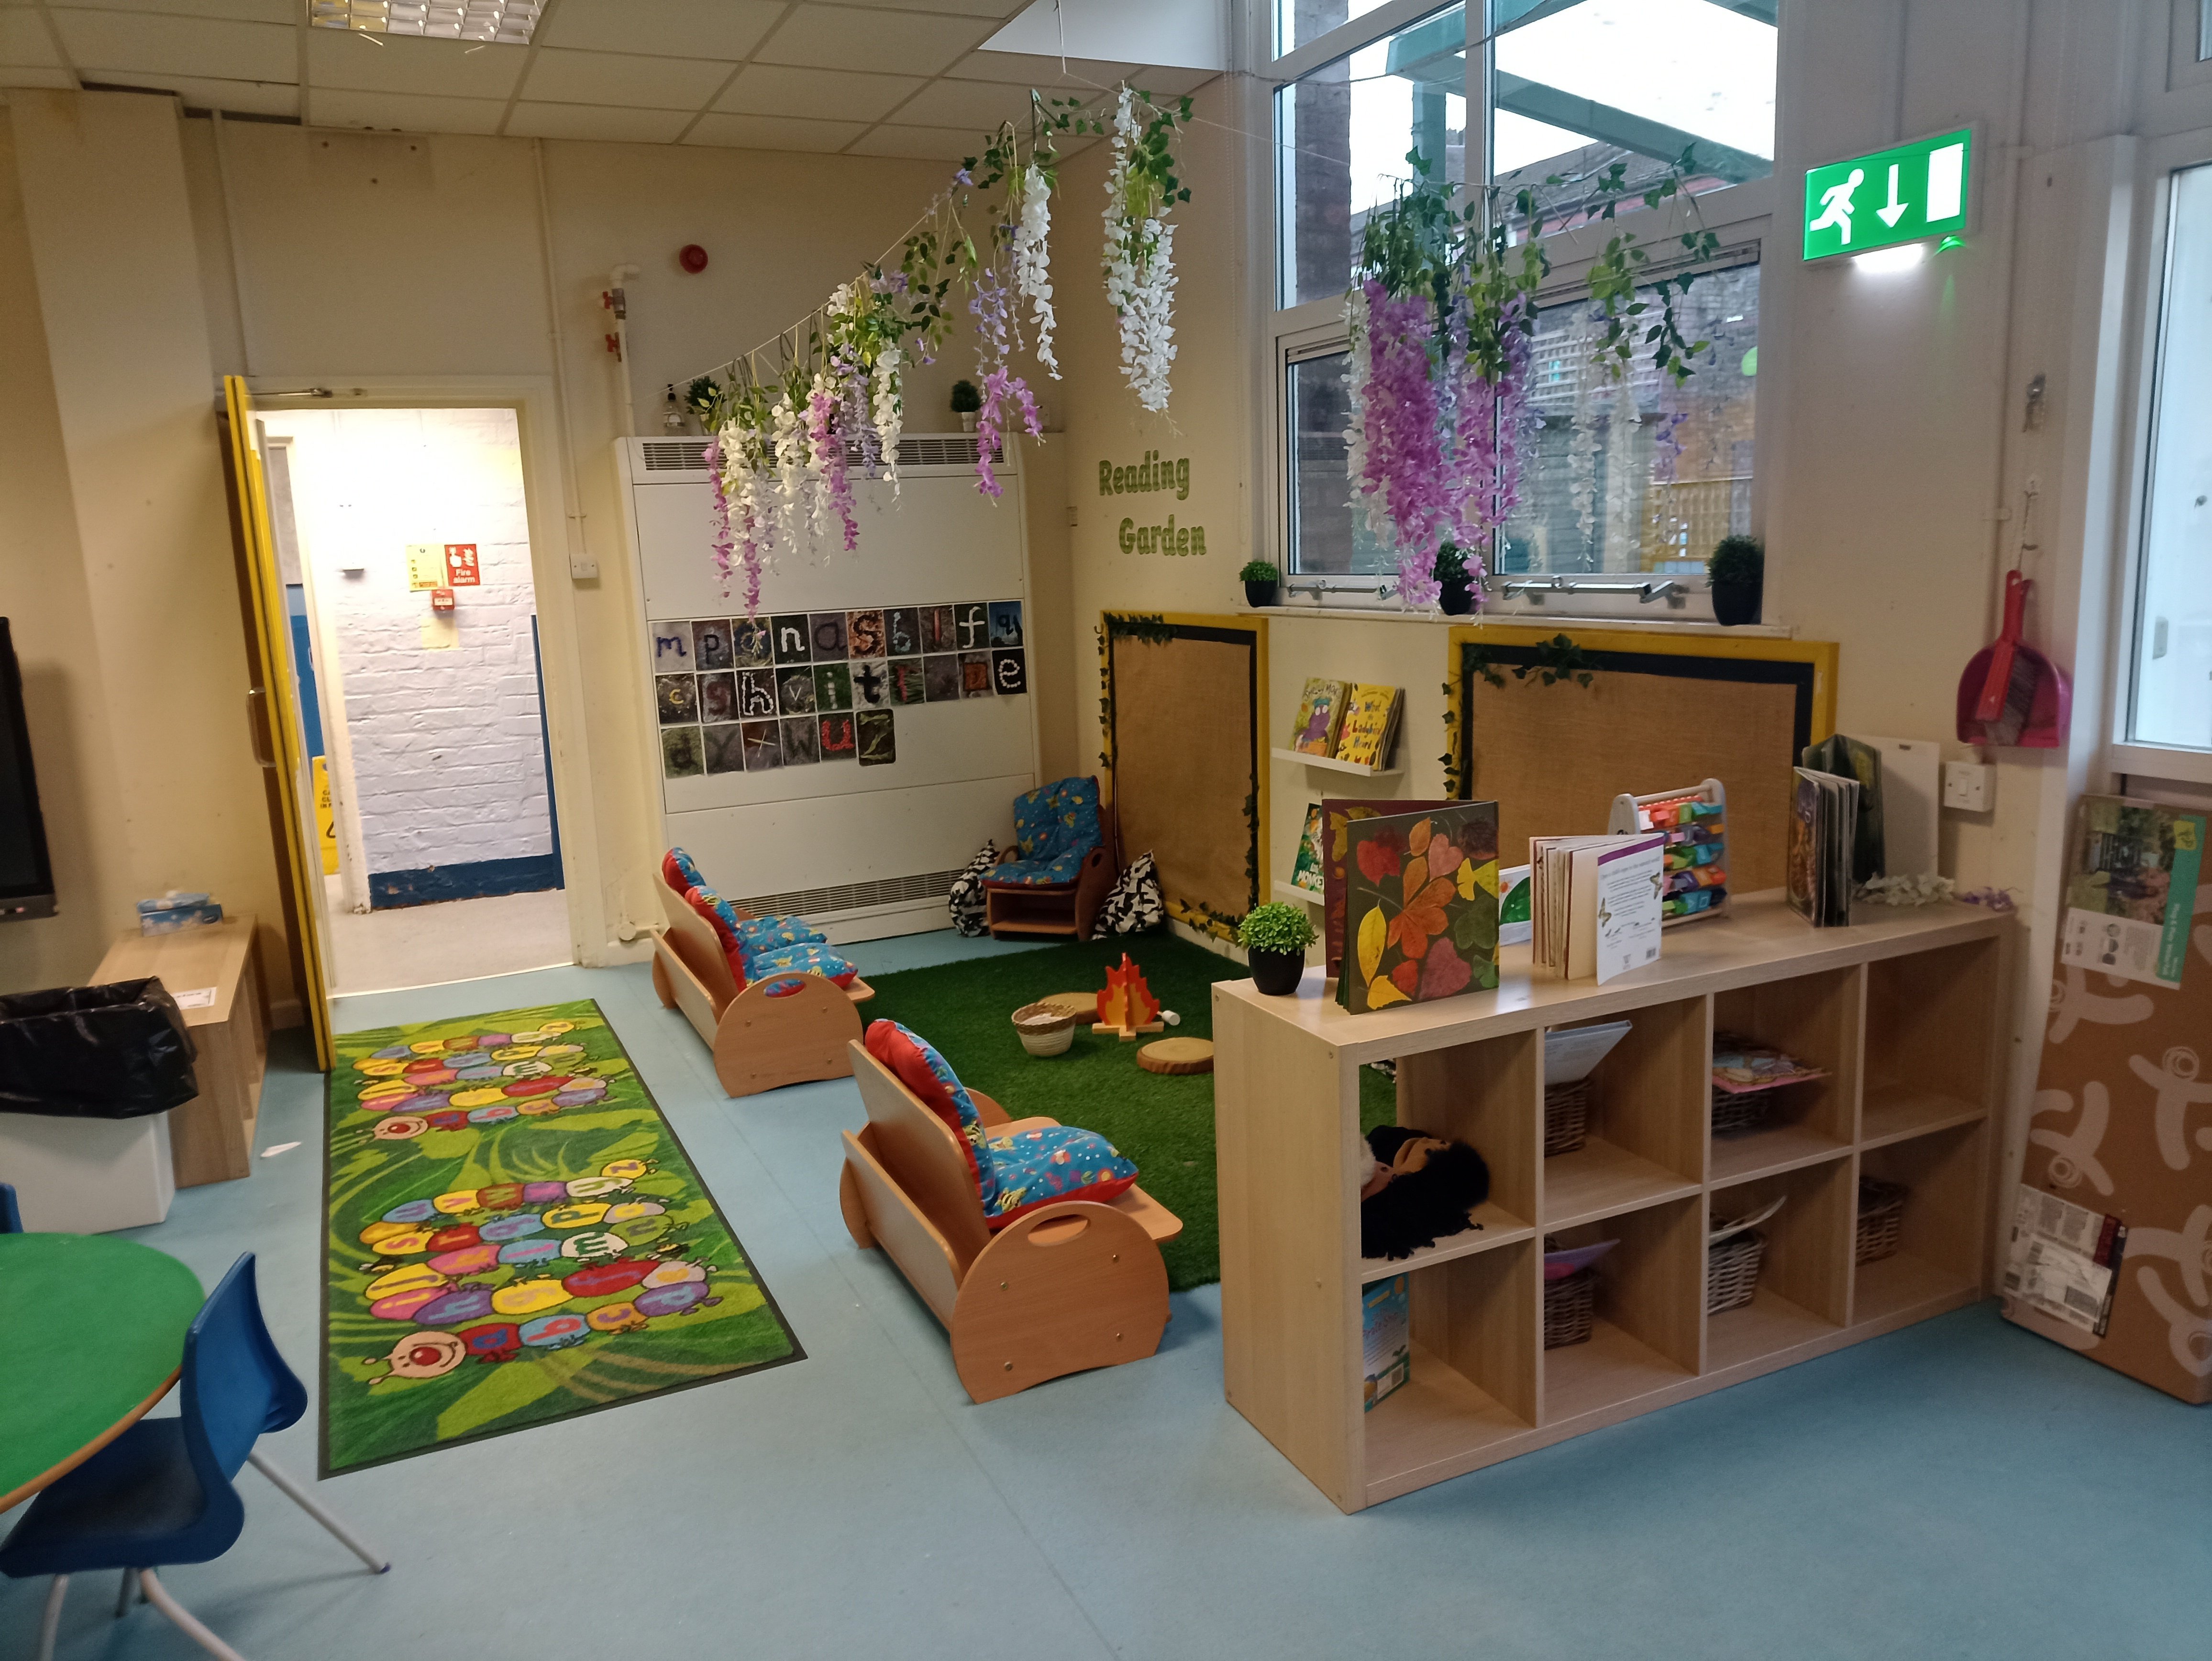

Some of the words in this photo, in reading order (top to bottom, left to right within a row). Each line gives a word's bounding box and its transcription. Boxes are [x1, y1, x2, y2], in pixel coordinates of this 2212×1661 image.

[1099, 450, 1190, 500] Reading
[1119, 514, 1207, 556] Garden
[453, 576, 476, 584] alarm
[656, 636, 687, 658] m
[703, 634, 719, 664] p
[781, 627, 805, 652] n
[814, 621, 847, 651] a
[893, 611, 911, 653] b
[959, 606, 985, 649] f
[998, 614, 1014, 635] q
[669, 688, 684, 705] c
[741, 671, 774, 716] h
[826, 671, 838, 709] i
[853, 664, 881, 704] t
[998, 658, 1021, 689] e
[821, 720, 855, 751] u
